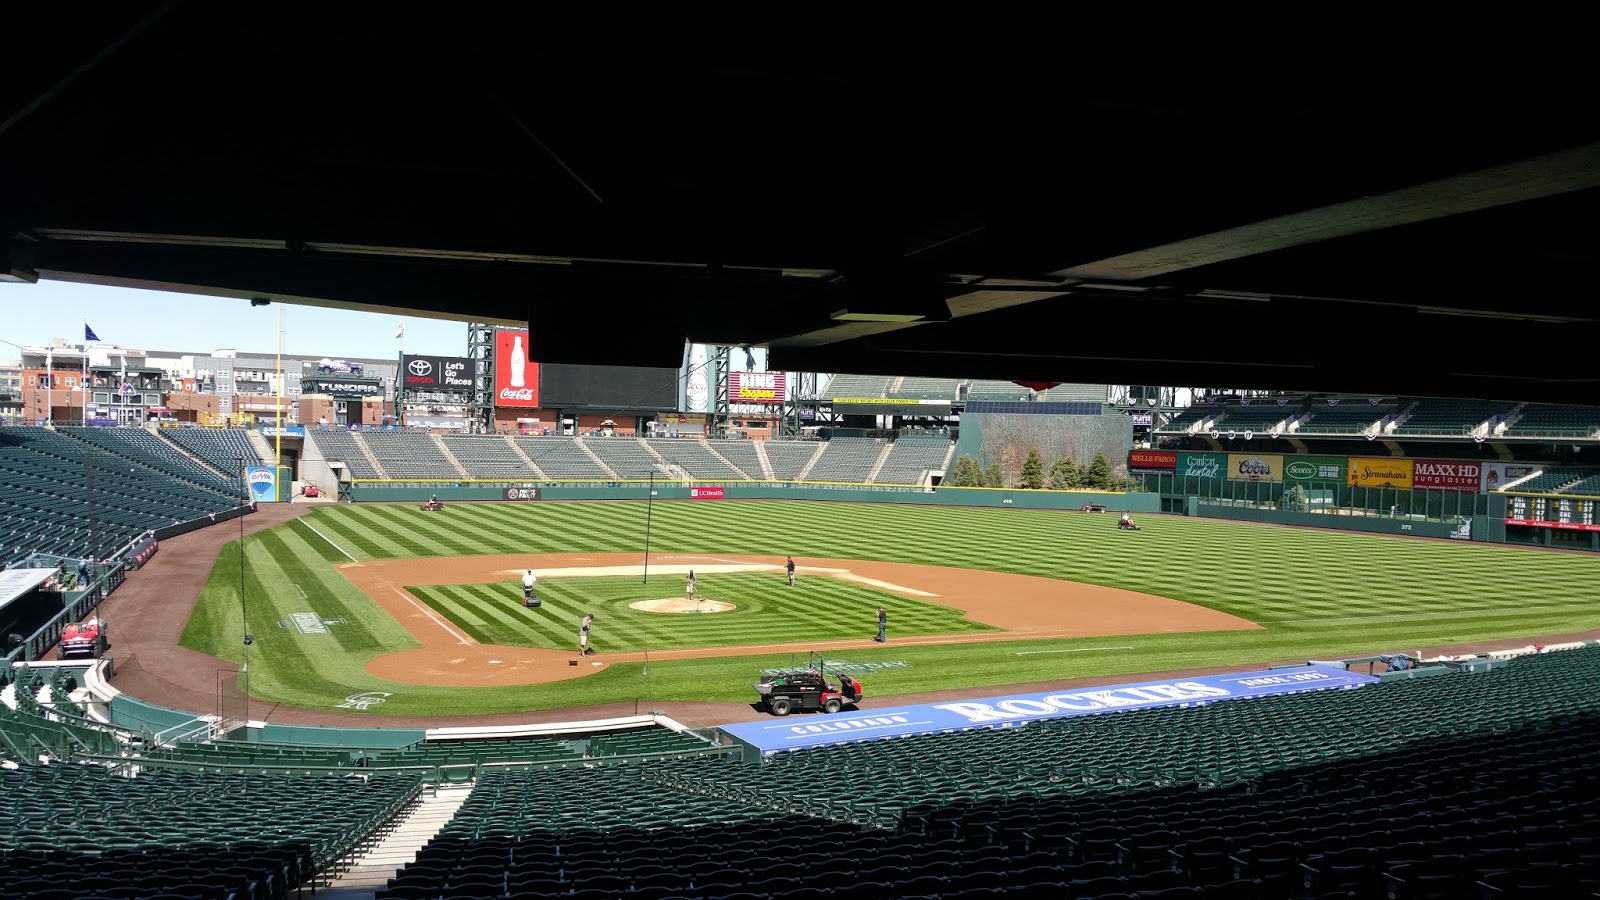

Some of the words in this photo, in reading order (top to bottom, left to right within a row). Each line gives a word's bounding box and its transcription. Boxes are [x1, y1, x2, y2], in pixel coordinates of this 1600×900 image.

[445, 362, 465, 370] Let's
[445, 377, 472, 386] Places
[740, 374, 775, 388] KING
[318, 383, 378, 393] TUNDRA
[500, 387, 534, 400] Coca-Cola
[738, 386, 776, 400] Soopers
[1133, 414, 1152, 422] PLATTE
[1154, 455, 1176, 463] FARGO
[1187, 454, 1216, 466] Comfort
[1185, 464, 1219, 478] dental
[1239, 460, 1271, 475] Coors
[1290, 465, 1312, 474] Scotts
[1361, 466, 1407, 481] Stranahan's
[1415, 463, 1456, 477] MAXX
[1458, 465, 1478, 477] HD
[1414, 475, 1478, 485] sunglasses
[932, 681, 1231, 723] ROCKIES
[790, 715, 908, 735] COLORADO
